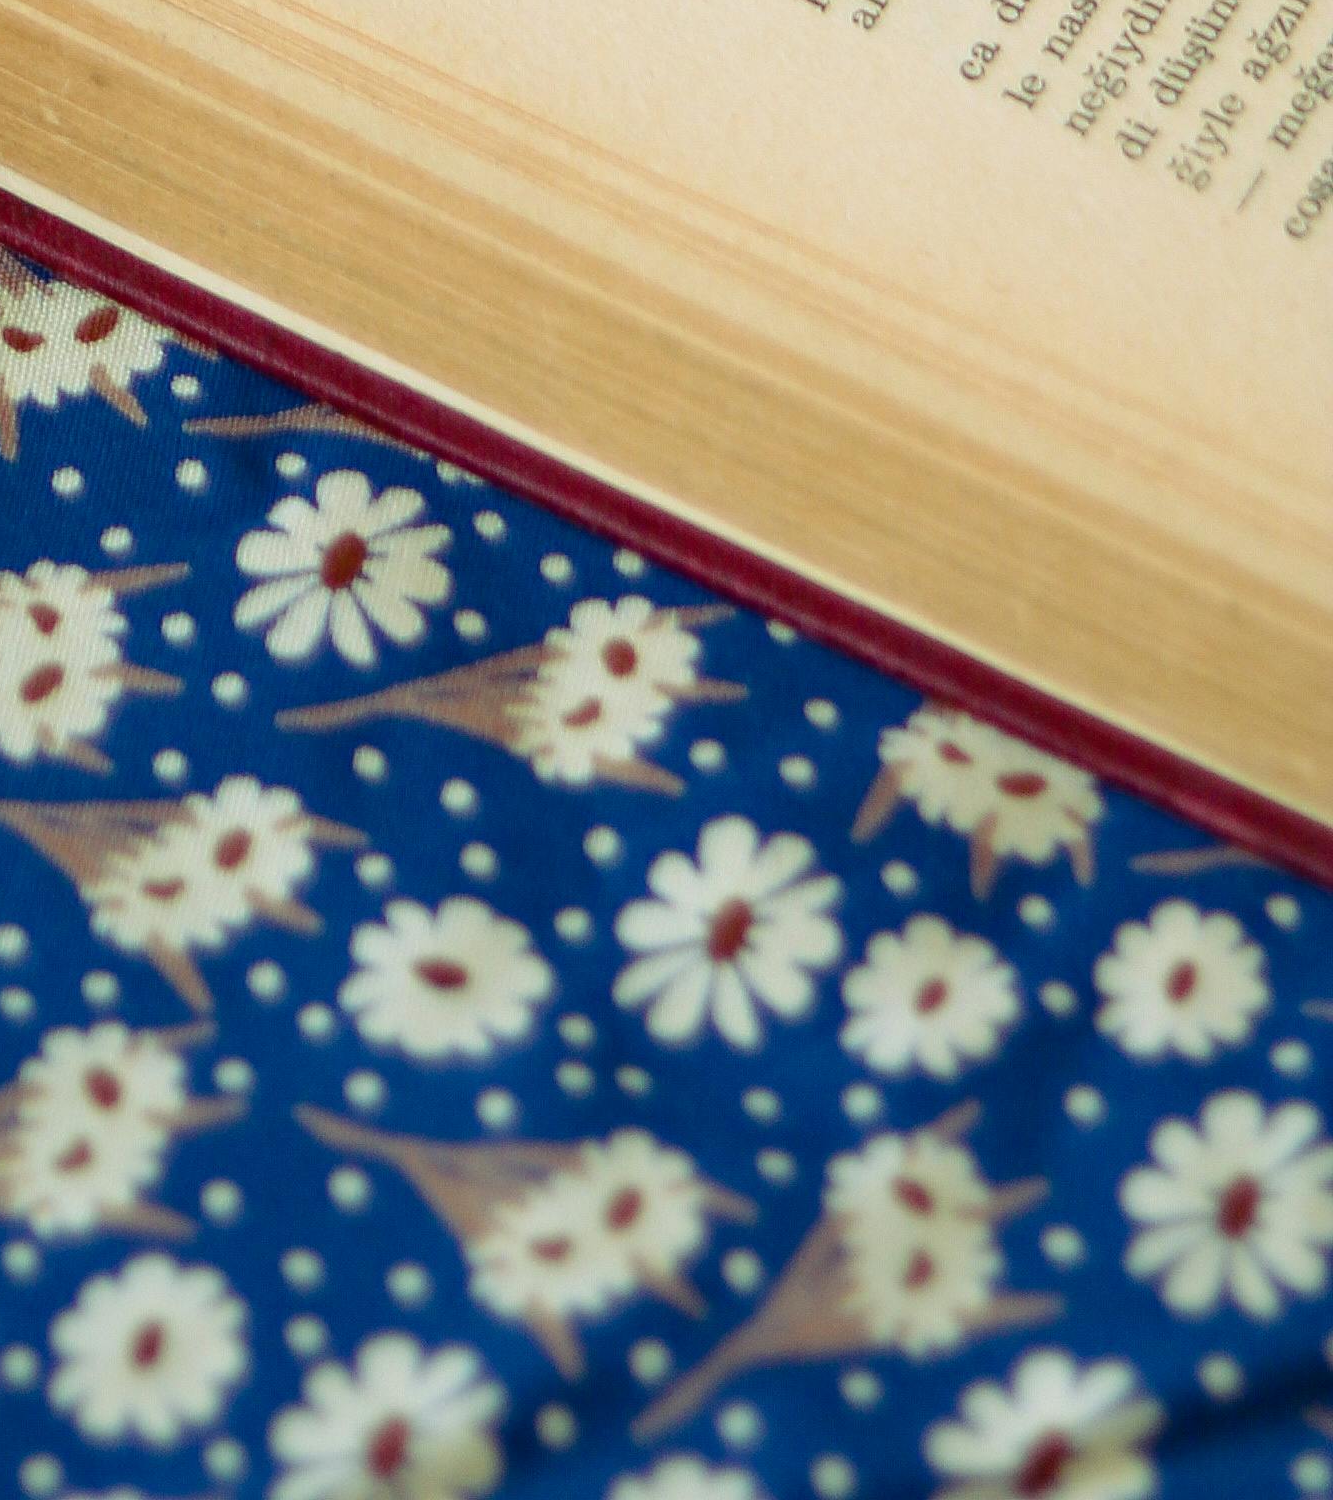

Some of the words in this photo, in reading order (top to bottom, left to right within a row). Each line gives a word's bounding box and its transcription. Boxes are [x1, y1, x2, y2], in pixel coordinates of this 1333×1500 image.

[960, 42, 1001, 83] ca
[1002, 74, 1046, 111] le
[1268, 38, 1333, 151] meğe
[1116, 119, 1159, 161] di
[1169, 94, 1246, 193] ğiyle
